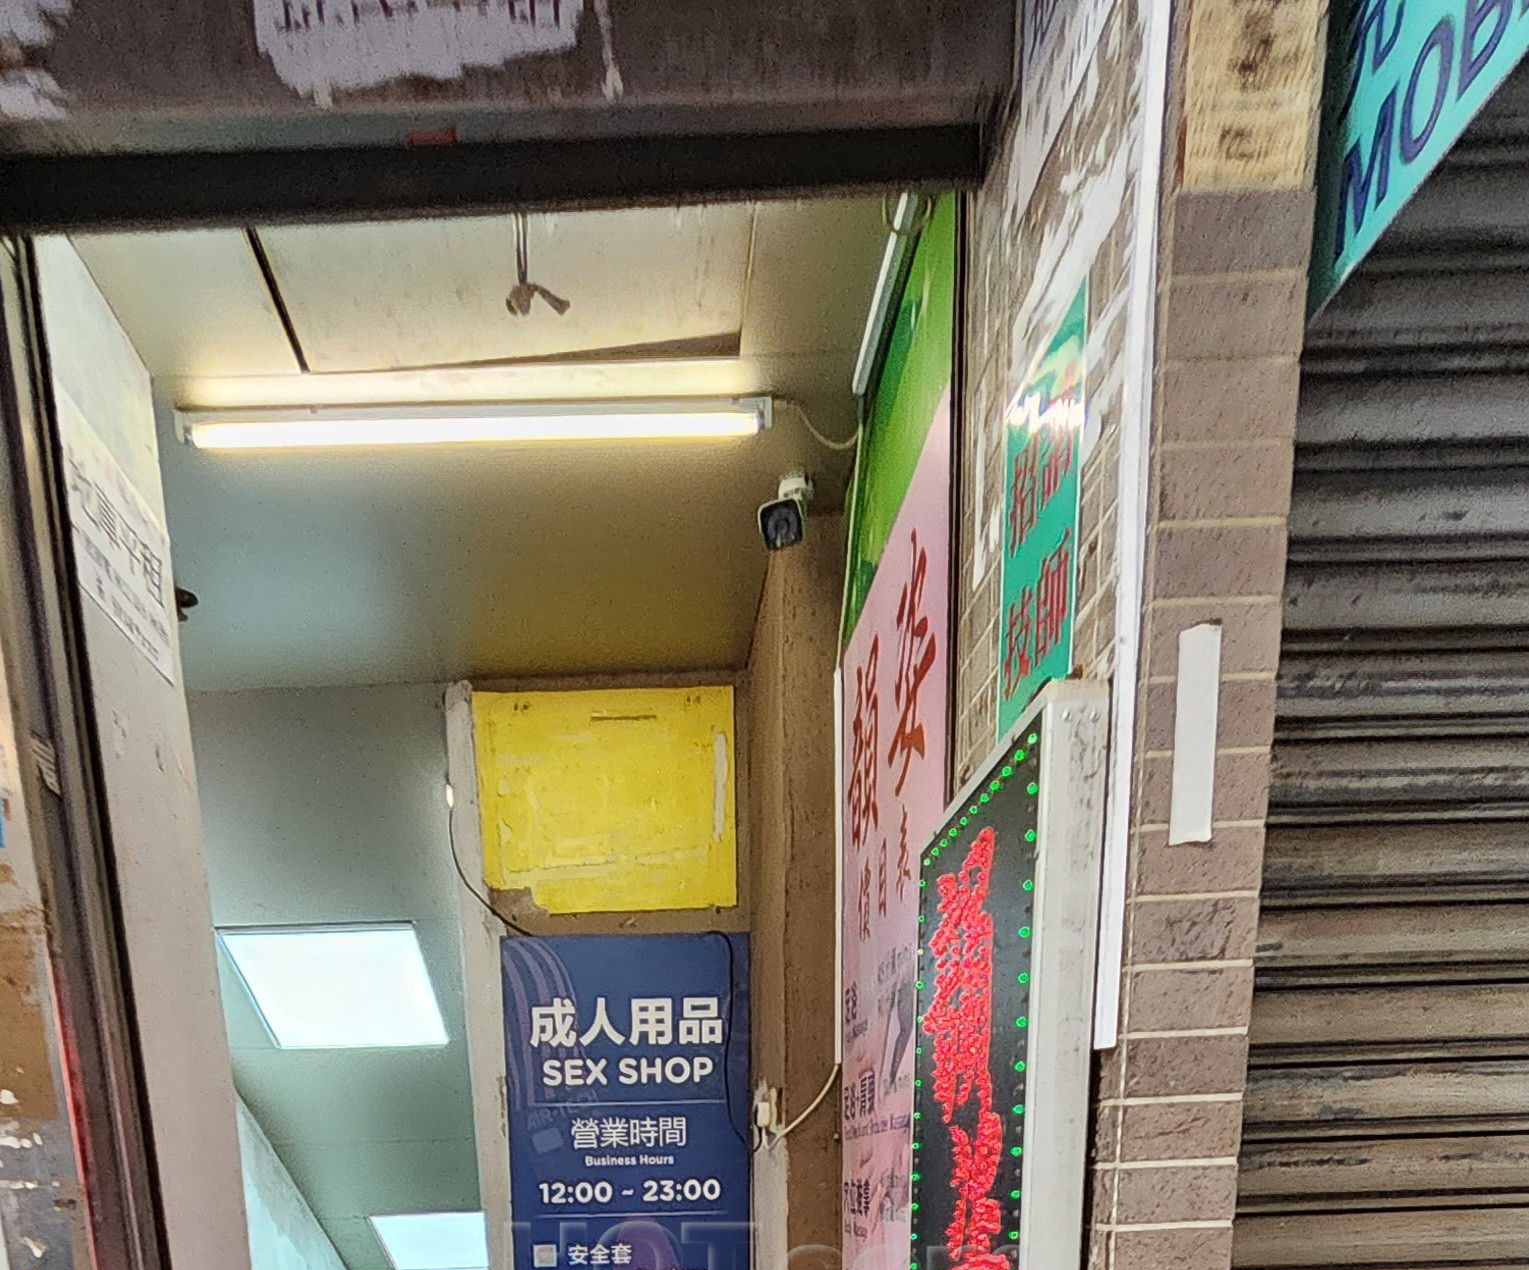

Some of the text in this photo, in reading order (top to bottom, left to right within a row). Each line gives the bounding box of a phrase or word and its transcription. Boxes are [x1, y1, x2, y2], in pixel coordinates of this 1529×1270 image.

[1333, 0, 1529, 265] MOB
[530, 997, 724, 1048] 成人用品
[543, 1056, 714, 1086] SEX SHOP
[571, 1116, 687, 1149] 營業時間
[585, 1153, 674, 1167] Business Hours
[539, 1181, 613, 1204] 12:00
[642, 1178, 721, 1203] 23:00
[568, 1243, 632, 1266] 安全套
